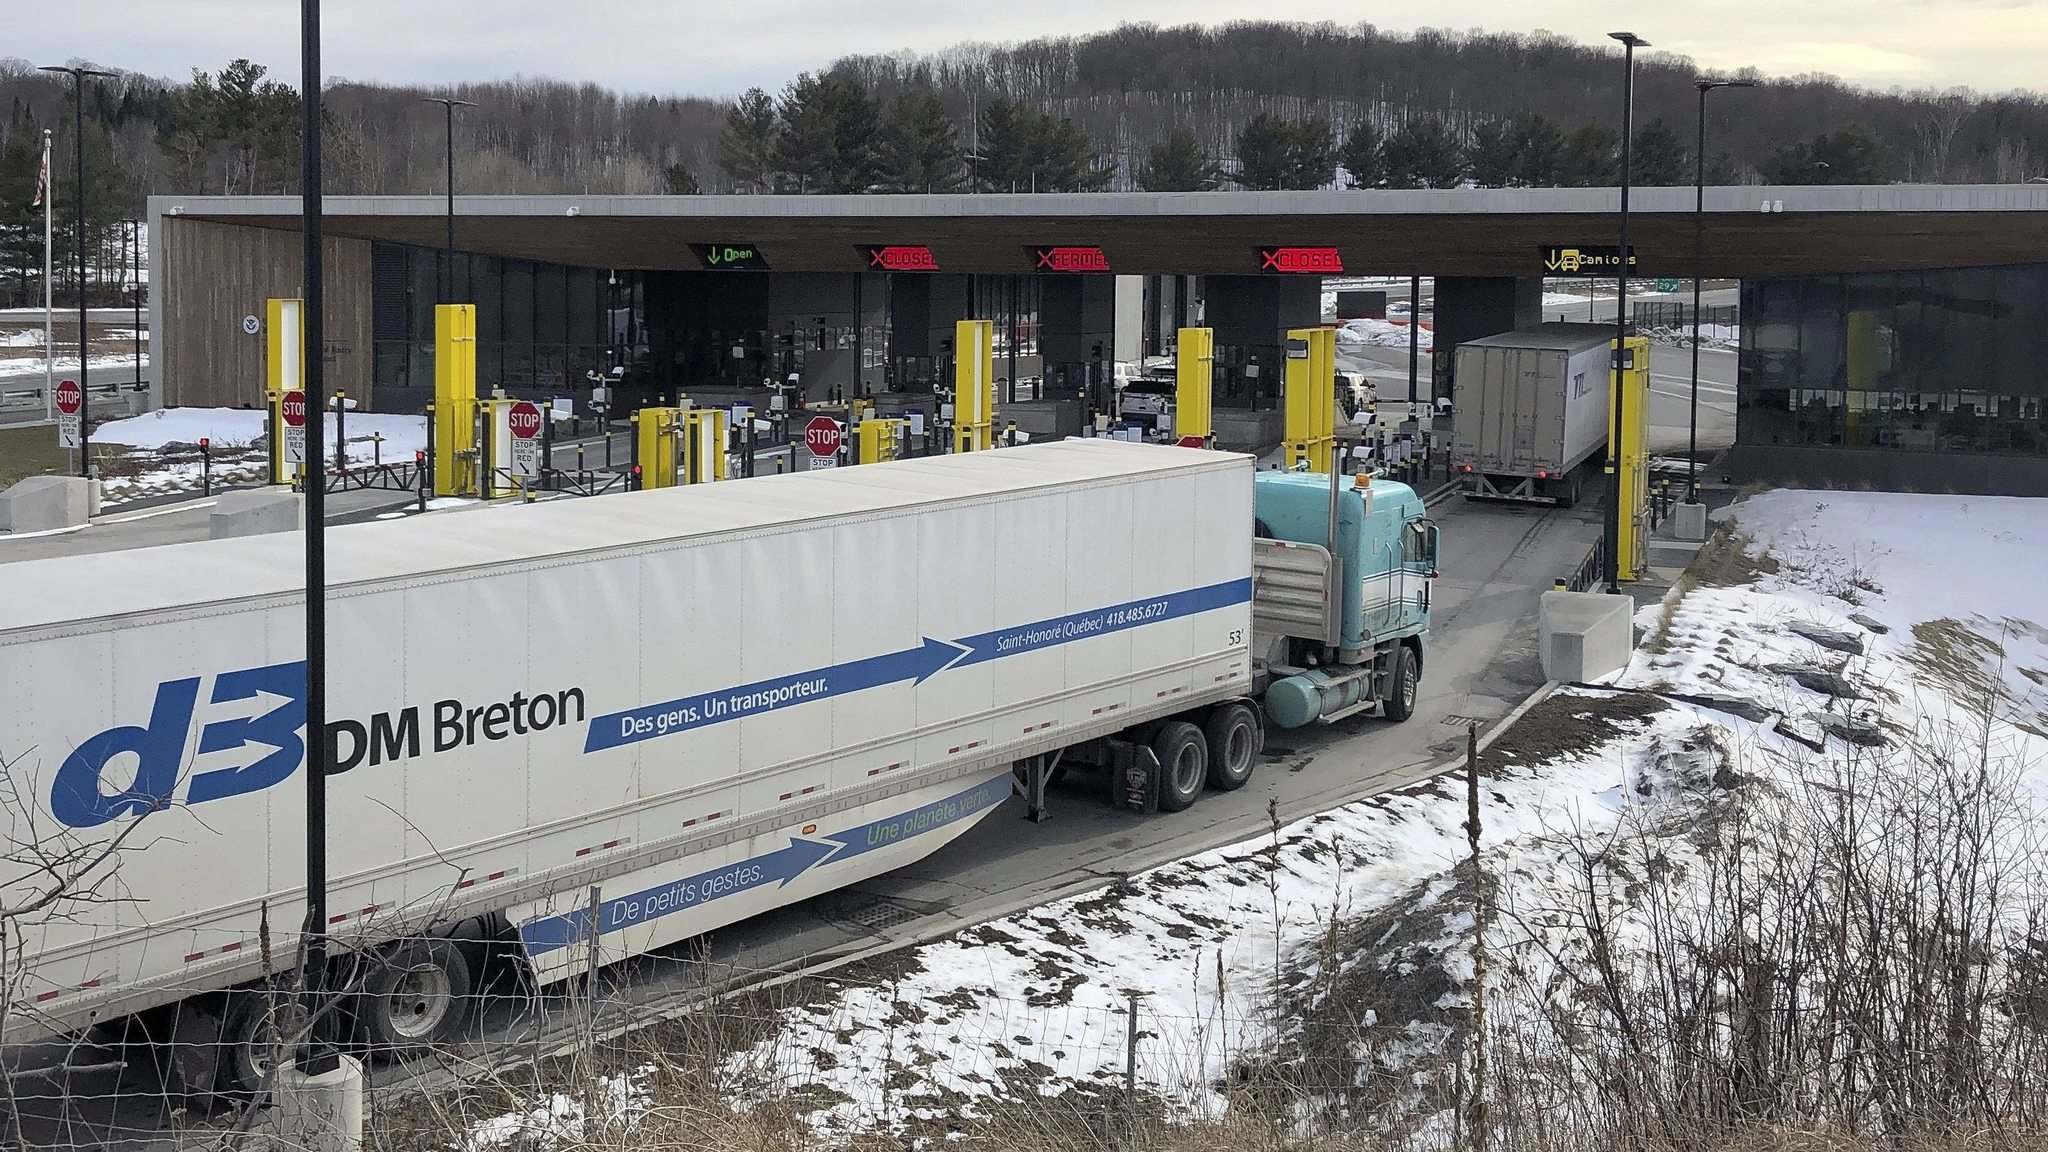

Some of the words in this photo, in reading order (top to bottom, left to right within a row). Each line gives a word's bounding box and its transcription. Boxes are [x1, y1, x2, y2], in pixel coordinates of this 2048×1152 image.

[724, 248, 752, 262] Open
[1578, 254, 1637, 265] Camios
[1658, 282, 1670, 290] 29
[57, 390, 80, 404] STOP
[509, 412, 539, 428] STOP
[808, 429, 839, 445] STOP
[289, 441, 304, 449] RED
[515, 441, 534, 449] STOP
[516, 454, 532, 462] RED
[813, 458, 834, 467] STOP
[996, 624, 1062, 651] Saint-Honoré
[1062, 615, 1104, 639] (Québec)
[1106, 601, 1169, 626] 418.485.6727
[621, 716, 654, 738] Des
[657, 706, 701, 734] gens.
[704, 698, 727, 718] Un
[730, 677, 828, 712] transporteur.
[325, 706, 421, 776] DM
[433, 687, 585, 753] Breton
[867, 822, 900, 846] Une
[902, 801, 956, 839] planète
[611, 900, 640, 926] De
[644, 884, 697, 920] petits
[701, 864, 765, 902] gestes.
